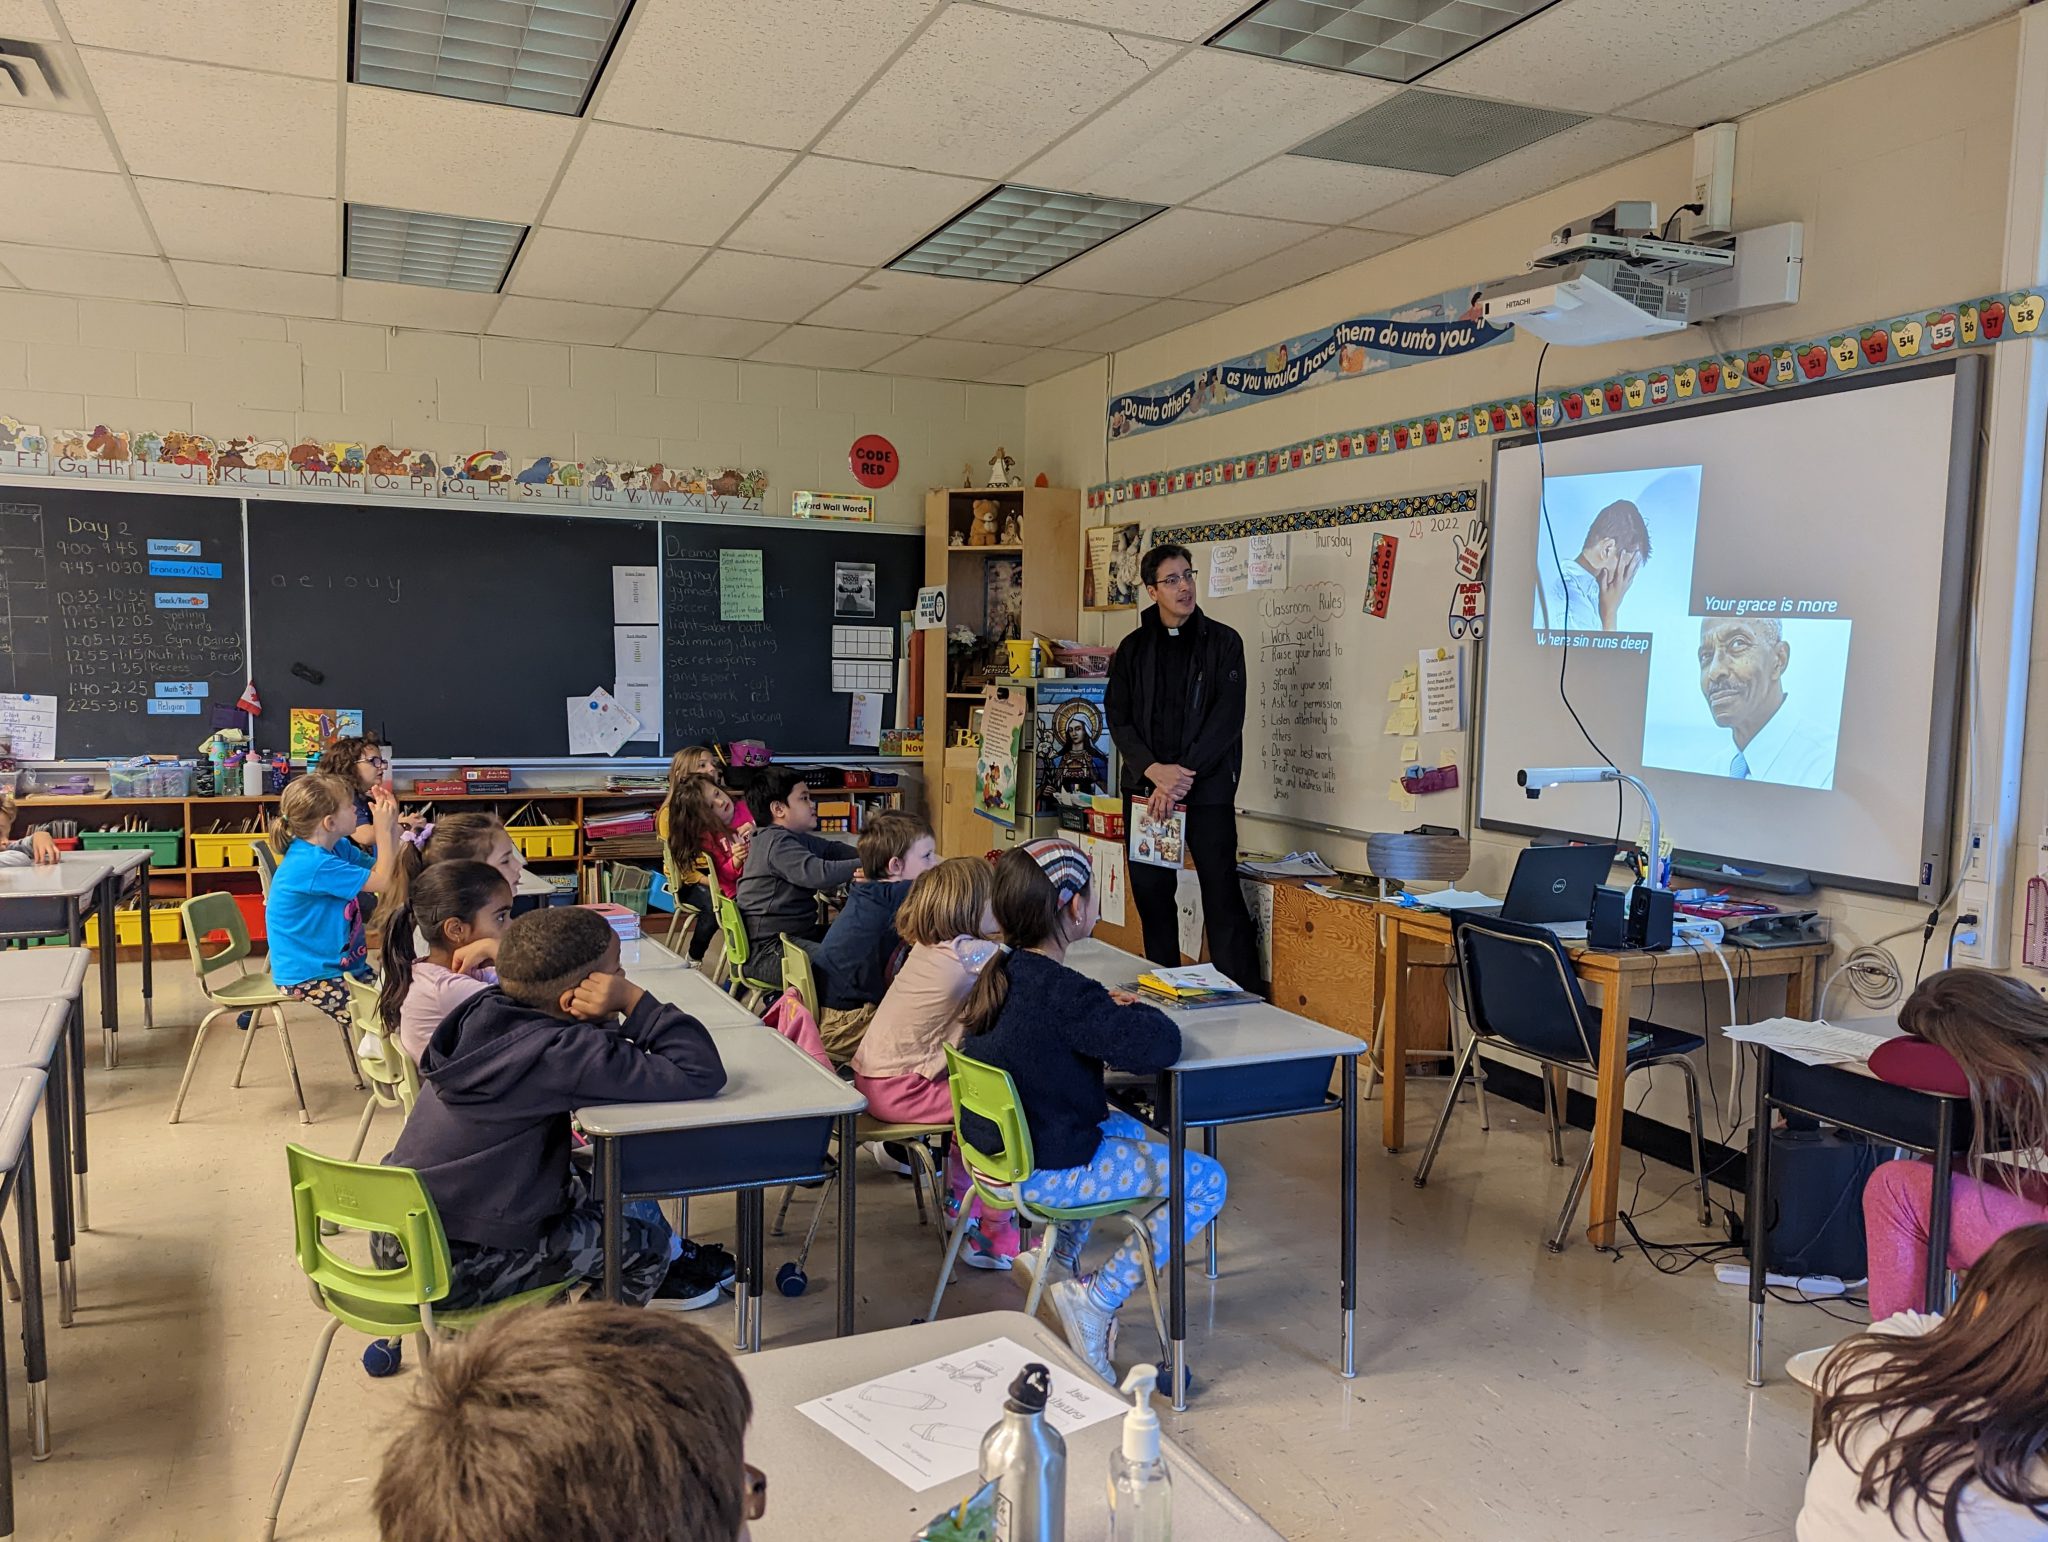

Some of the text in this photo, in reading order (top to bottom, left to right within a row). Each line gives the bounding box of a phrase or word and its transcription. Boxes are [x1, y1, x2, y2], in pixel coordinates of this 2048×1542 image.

[1506, 297, 1531, 309] HITACHI
[1138, 403, 1159, 422] unto
[1226, 371, 1240, 385] as
[1243, 375, 1261, 391] you
[1263, 363, 1299, 390] would
[1303, 342, 1336, 377] have
[1335, 324, 1375, 345] them
[1379, 323, 1399, 347] do
[1401, 332, 1438, 351] unto
[1478, 418, 1487, 426] 36
[1511, 413, 1519, 421] 38
[1542, 408, 1552, 416] 40
[1569, 402, 1578, 411] 41
[1590, 398, 1600, 406] 42
[1629, 390, 1641, 399] 44
[1654, 385, 1666, 394] 45
[1680, 379, 1691, 388] 46
[1704, 374, 1715, 384] 47
[1753, 365, 1764, 375] 49
[1780, 362, 1791, 372] 50
[1808, 358, 1821, 369] 51
[1839, 350, 1854, 362] 52
[1869, 343, 1883, 354] 53
[1899, 335, 1914, 347] 54
[1935, 327, 1952, 339] 55
[1964, 321, 1974, 332] 56
[1986, 317, 1999, 328] 57
[2017, 309, 2035, 322] 58
[855, 447, 892, 463] CODE
[861, 462, 885, 475] RED
[800, 501, 868, 513] Word Wall Words
[67, 517, 132, 541] Day 2
[1430, 517, 1460, 533] 2022
[665, 535, 719, 559] Drama
[1313, 530, 1353, 558] Thursday
[1376, 541, 1393, 612] October
[271, 574, 401, 604] a e o u y
[1460, 583, 1482, 594] EYES
[1265, 591, 1342, 617] Classroom Rules
[1463, 594, 1477, 606] ON
[1704, 595, 1838, 615] Your grace is more
[1462, 605, 1477, 617] ME
[164, 632, 192, 650] Gym
[1270, 626, 1291, 644] Work
[1296, 624, 1324, 648] quietly
[1536, 632, 1650, 654] Where sin runs deep
[209, 650, 241, 663] Break
[1271, 645, 1292, 662] Raise
[1295, 648, 1311, 665] your
[1312, 641, 1331, 658] hand
[1335, 642, 1343, 657] to
[1275, 661, 1297, 681] speak
[163, 685, 179, 694] Math
[1092, 687, 1104, 695] Mary
[1260, 675, 1332, 698] 3 Stay in your seat
[156, 700, 186, 712] Religion
[1271, 696, 1286, 709] Ask
[1288, 694, 1298, 708] for
[1303, 699, 1342, 716] permission
[1270, 713, 1291, 726] Listen
[1294, 711, 1328, 735] attentively
[1329, 712, 1338, 726] to
[955, 728, 981, 748] Be
[1271, 728, 1292, 742] others
[905, 743, 924, 753] Nov
[1261, 742, 1332, 763] 6 Do your best work
[1271, 759, 1289, 773] Treat
[1291, 764, 1319, 782] everyone
[1321, 766, 1336, 781] with
[1285, 774, 1296, 789] and
[1324, 780, 1335, 794] like
